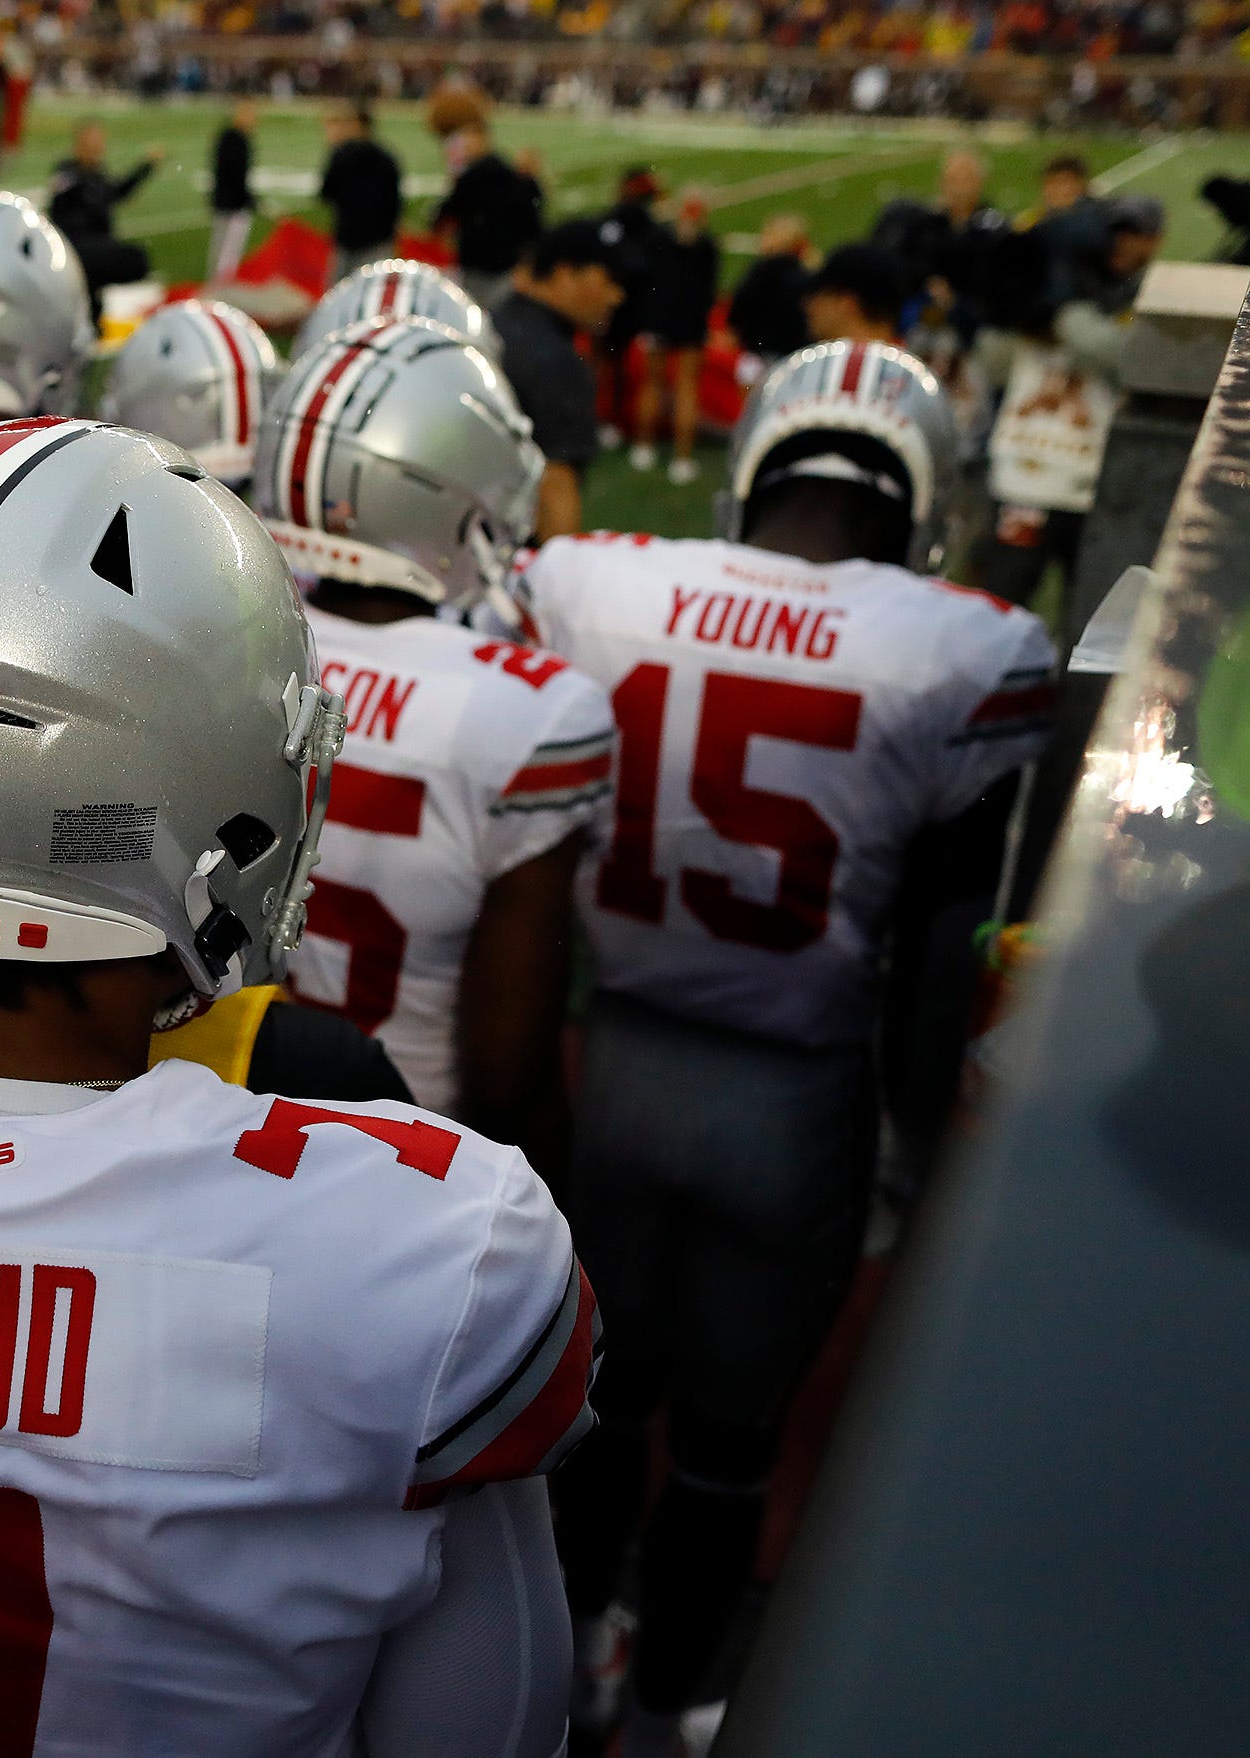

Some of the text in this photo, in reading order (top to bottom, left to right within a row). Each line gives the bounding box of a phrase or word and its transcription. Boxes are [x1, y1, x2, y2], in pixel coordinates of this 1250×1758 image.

[664, 585, 846, 661] YOUNG
[82, 802, 136, 811] WARNING
[597, 663, 864, 956] 15
[232, 1097, 462, 1182] 7
